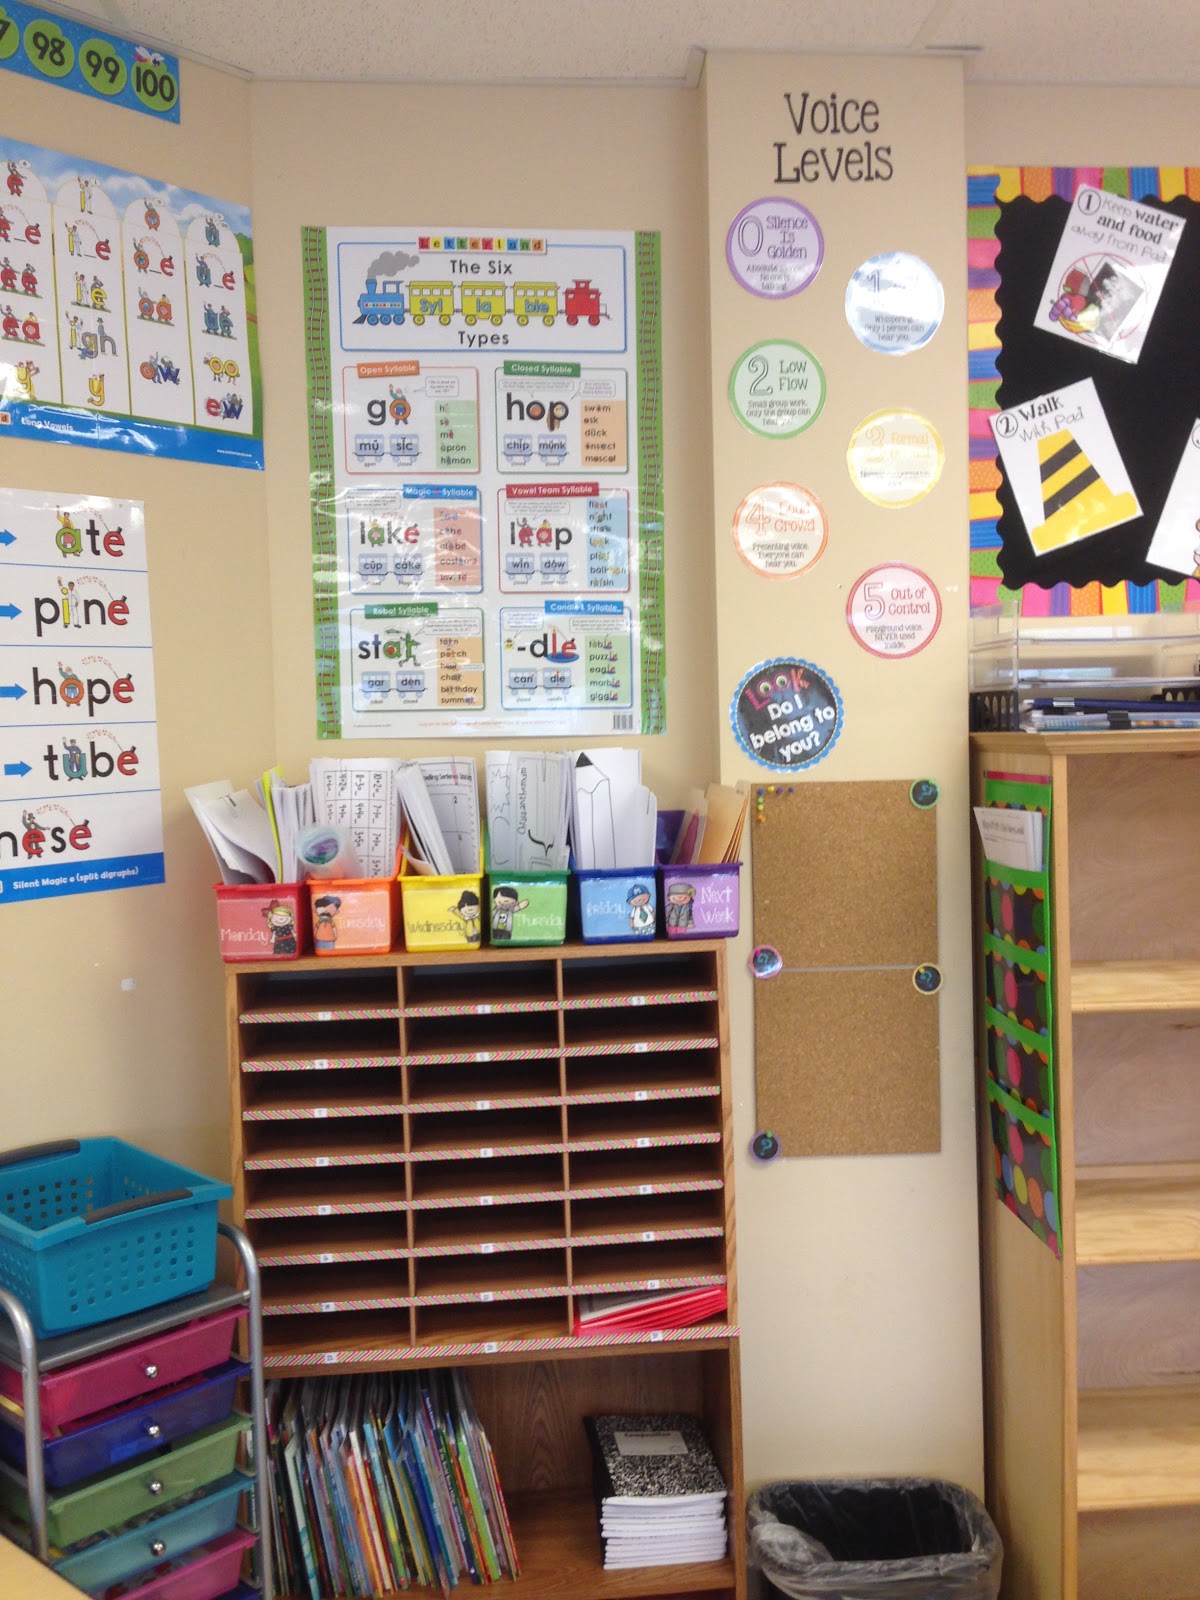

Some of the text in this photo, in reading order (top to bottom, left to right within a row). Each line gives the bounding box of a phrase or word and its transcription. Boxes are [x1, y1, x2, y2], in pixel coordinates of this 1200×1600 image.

[32, 31, 66, 67] 98
[86, 50, 120, 84] 99
[135, 66, 175, 102] 100
[783, 92, 880, 135] Voice
[773, 141, 893, 184] Levels
[766, 215, 808, 230] Silence
[1102, 198, 1132, 217] Keep
[1135, 209, 1180, 232] water
[738, 215, 763, 258] 0
[780, 230, 795, 244] Is
[1071, 223, 1105, 244] away
[1107, 234, 1139, 253] from
[1096, 215, 1163, 245] and food
[767, 244, 807, 260] Golden
[450, 260, 512, 274] The Six
[419, 299, 443, 315] Syl
[476, 299, 492, 313] la
[525, 299, 549, 313] ble
[458, 331, 510, 348] Types
[360, 363, 416, 375] Open Syllable
[511, 363, 572, 374] Closed Syllable
[748, 354, 773, 396] 2
[779, 360, 807, 374] Low
[779, 377, 808, 391] Flow
[206, 396, 244, 420] ew
[367, 398, 411, 426] go
[505, 392, 569, 432] hop
[768, 400, 789, 409] group
[777, 409, 797, 418] group
[797, 408, 811, 416] can
[1017, 396, 1064, 422] Walk
[43, 420, 73, 432] Vowels
[405, 487, 431, 496] Magic
[442, 487, 474, 497] Syllable
[512, 485, 593, 495] Vowel Team Syllable
[745, 500, 771, 537] 4
[774, 518, 815, 533] Crowd
[56, 519, 125, 557] ate
[360, 521, 420, 545] lake
[510, 521, 573, 550] leap
[752, 543, 790, 552] Presenting
[758, 551, 804, 560] Everyone can
[765, 560, 781, 568] hear
[863, 582, 885, 621] 5
[891, 587, 927, 600] Out of
[34, 586, 130, 637] pine
[373, 606, 429, 615] Robot Syllable
[550, 603, 578, 612] Candle
[587, 604, 618, 613] Syllable
[889, 602, 931, 616] Control
[866, 625, 904, 634] Playground
[874, 632, 915, 641] NEVER used
[32, 667, 135, 717] hope
[767, 693, 803, 720] Do I
[750, 705, 836, 749] belong to
[779, 730, 820, 762] you?
[43, 741, 139, 781] tube
[13, 880, 40, 890] Silent
[41, 877, 68, 889] Magic
[76, 872, 99, 882] (split
[100, 866, 139, 881] digraphs)
[701, 884, 733, 905] Next
[338, 915, 386, 933] Tuesday
[701, 908, 734, 926] Week
[408, 918, 467, 936] Wednesday
[220, 927, 270, 947] Monday
